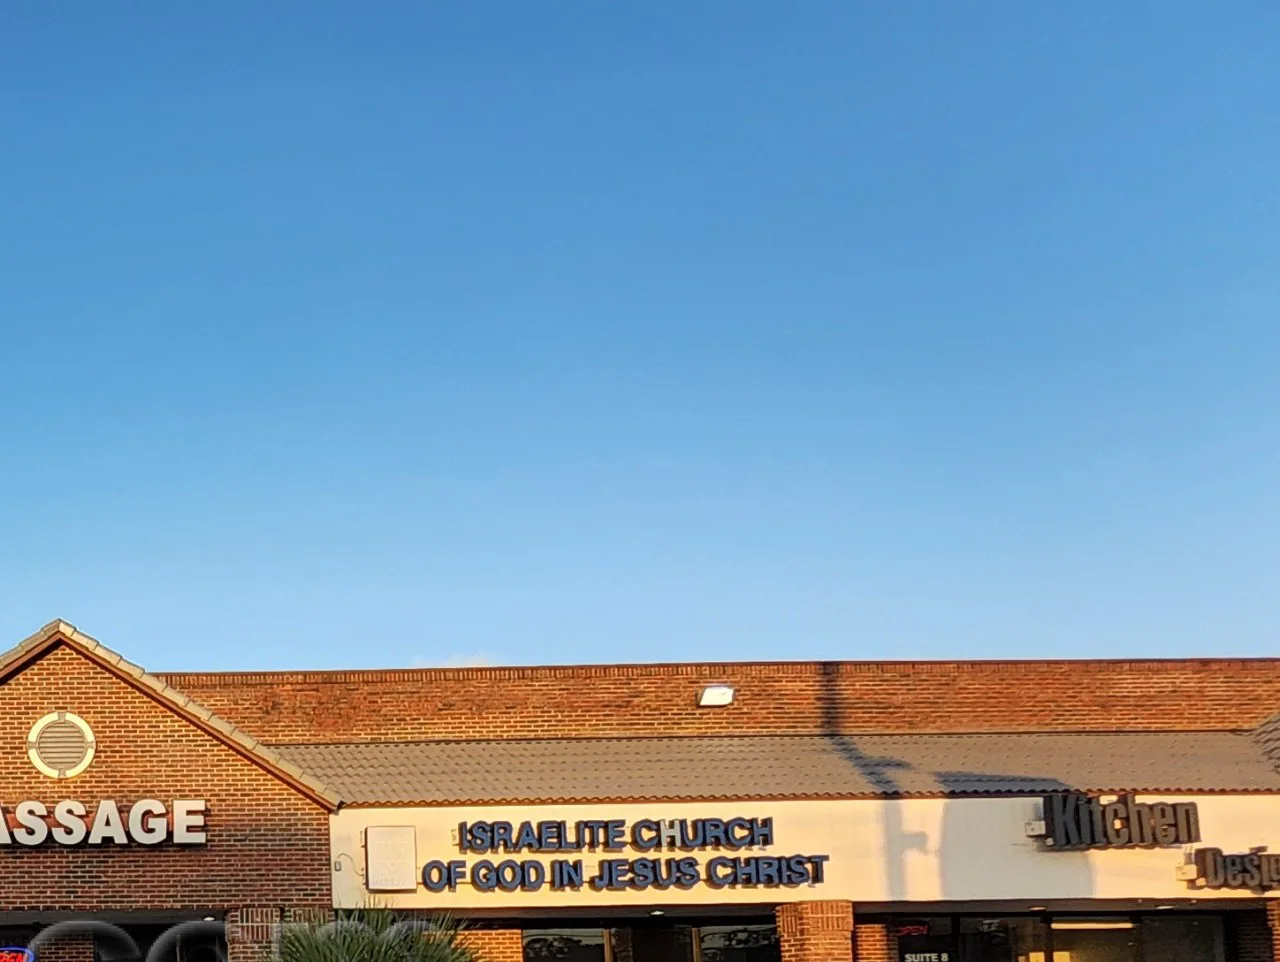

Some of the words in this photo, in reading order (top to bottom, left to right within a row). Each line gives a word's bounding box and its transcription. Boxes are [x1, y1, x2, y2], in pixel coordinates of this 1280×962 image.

[459, 819, 626, 853] ISRAELITE
[631, 817, 773, 851] CHURCH
[1051, 793, 1201, 846] Kitchen
[422, 860, 467, 892] OF
[472, 859, 545, 891] GOD
[553, 859, 583, 889] IN
[591, 857, 700, 890] JESUS
[706, 855, 829, 889] CHRIST
[904, 953, 939, 962] SUITE
[940, 952, 949, 962] 8
